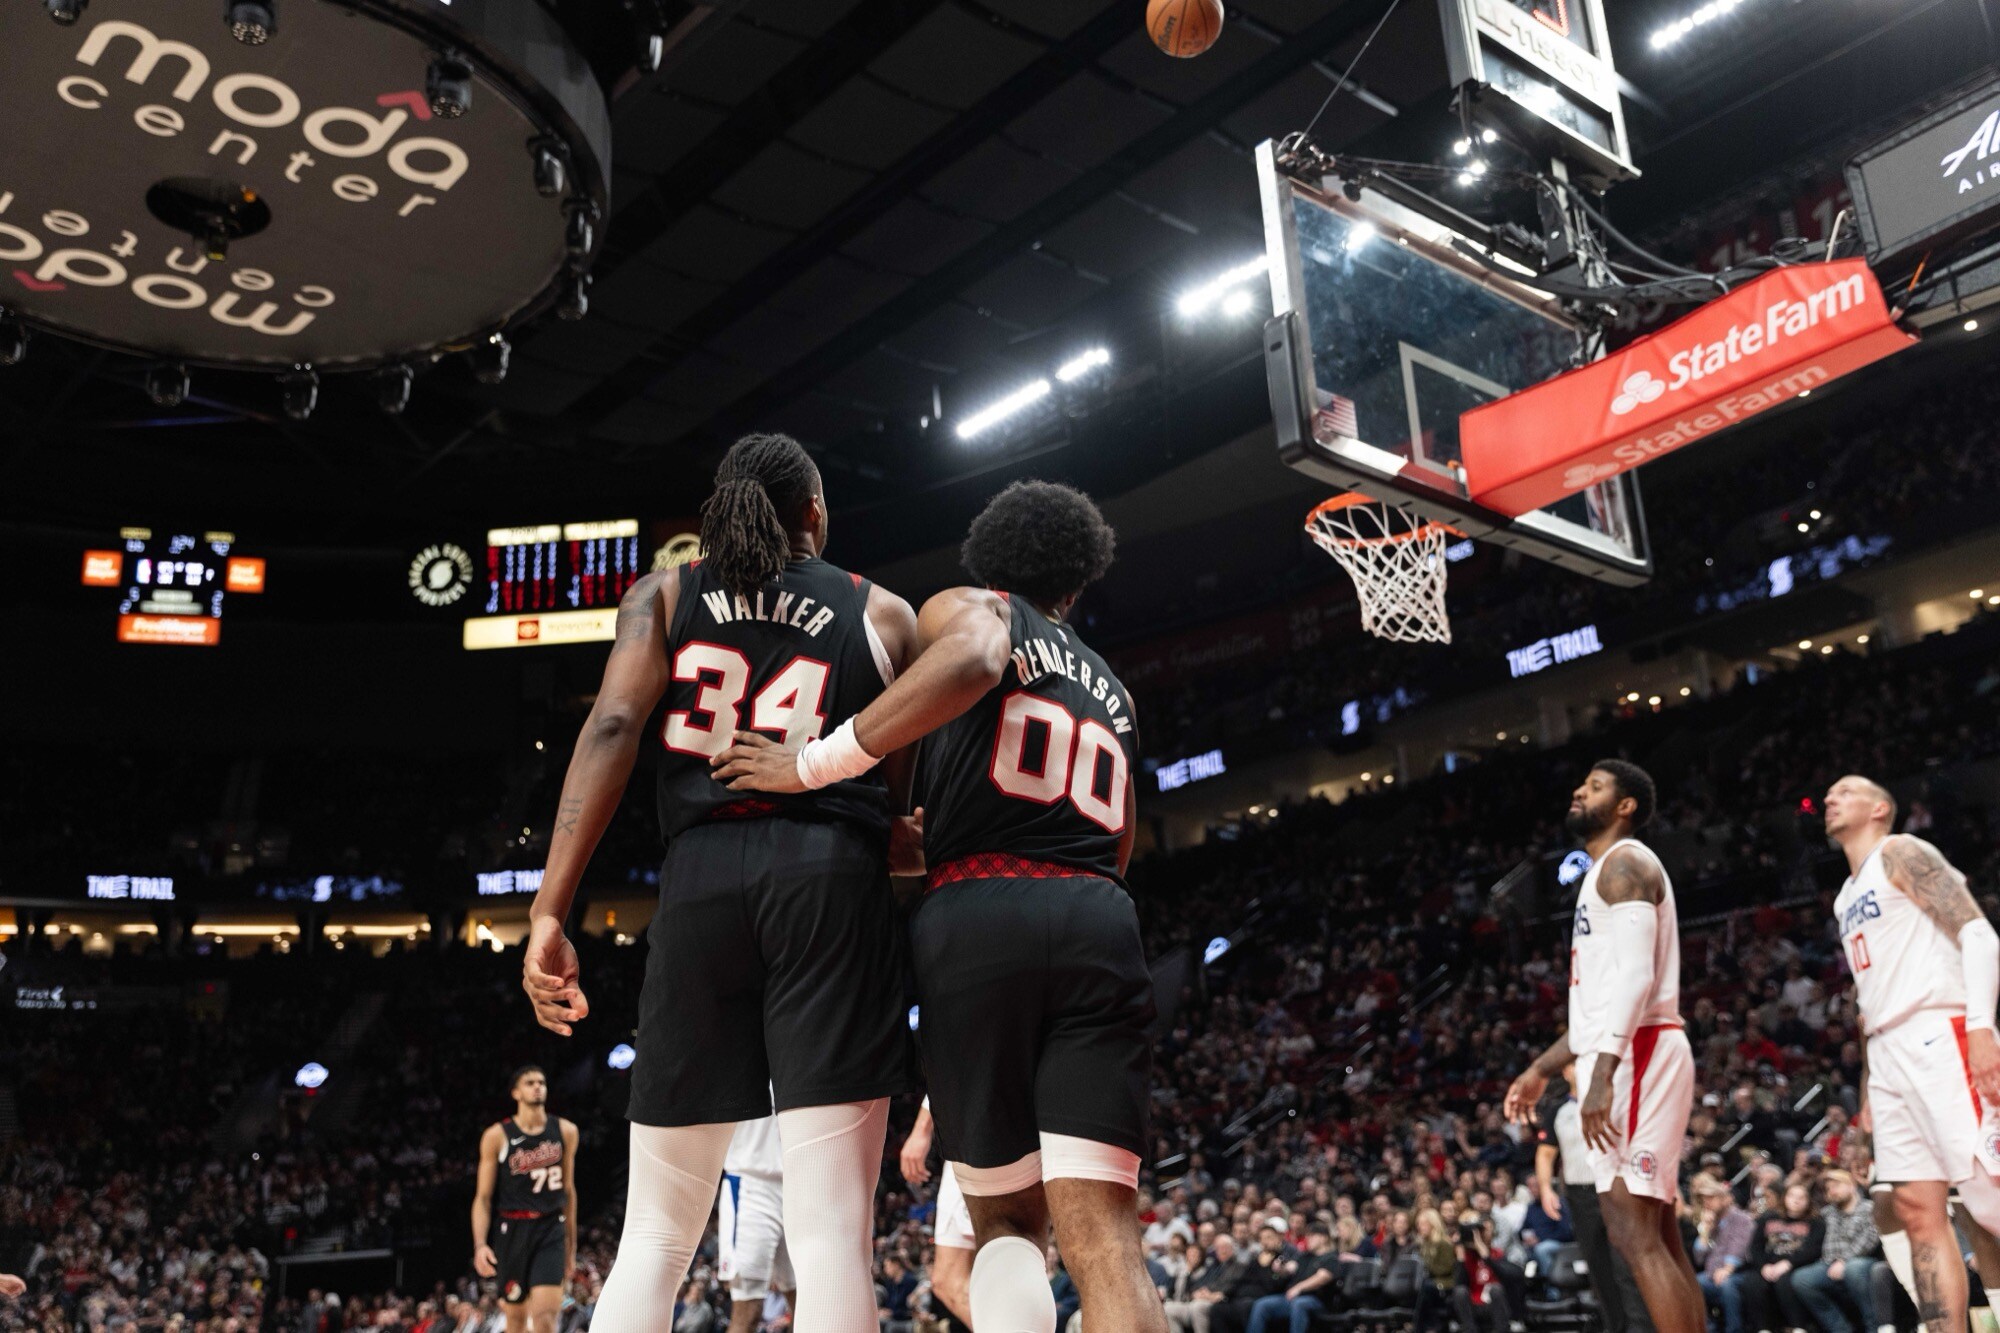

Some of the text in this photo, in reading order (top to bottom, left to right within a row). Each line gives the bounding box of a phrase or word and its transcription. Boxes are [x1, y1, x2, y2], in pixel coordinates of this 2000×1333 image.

[56, 75, 437, 217] center
[76, 19, 469, 192] moda
[702, 590, 835, 638] WALKER
[1550, 624, 1604, 661] TRAIL
[659, 640, 832, 760] 34
[1010, 637, 1133, 735] HENDERSON
[988, 688, 1129, 835] 00
[130, 876, 175, 899] TRAIL
[530, 1166, 563, 1193] 72
